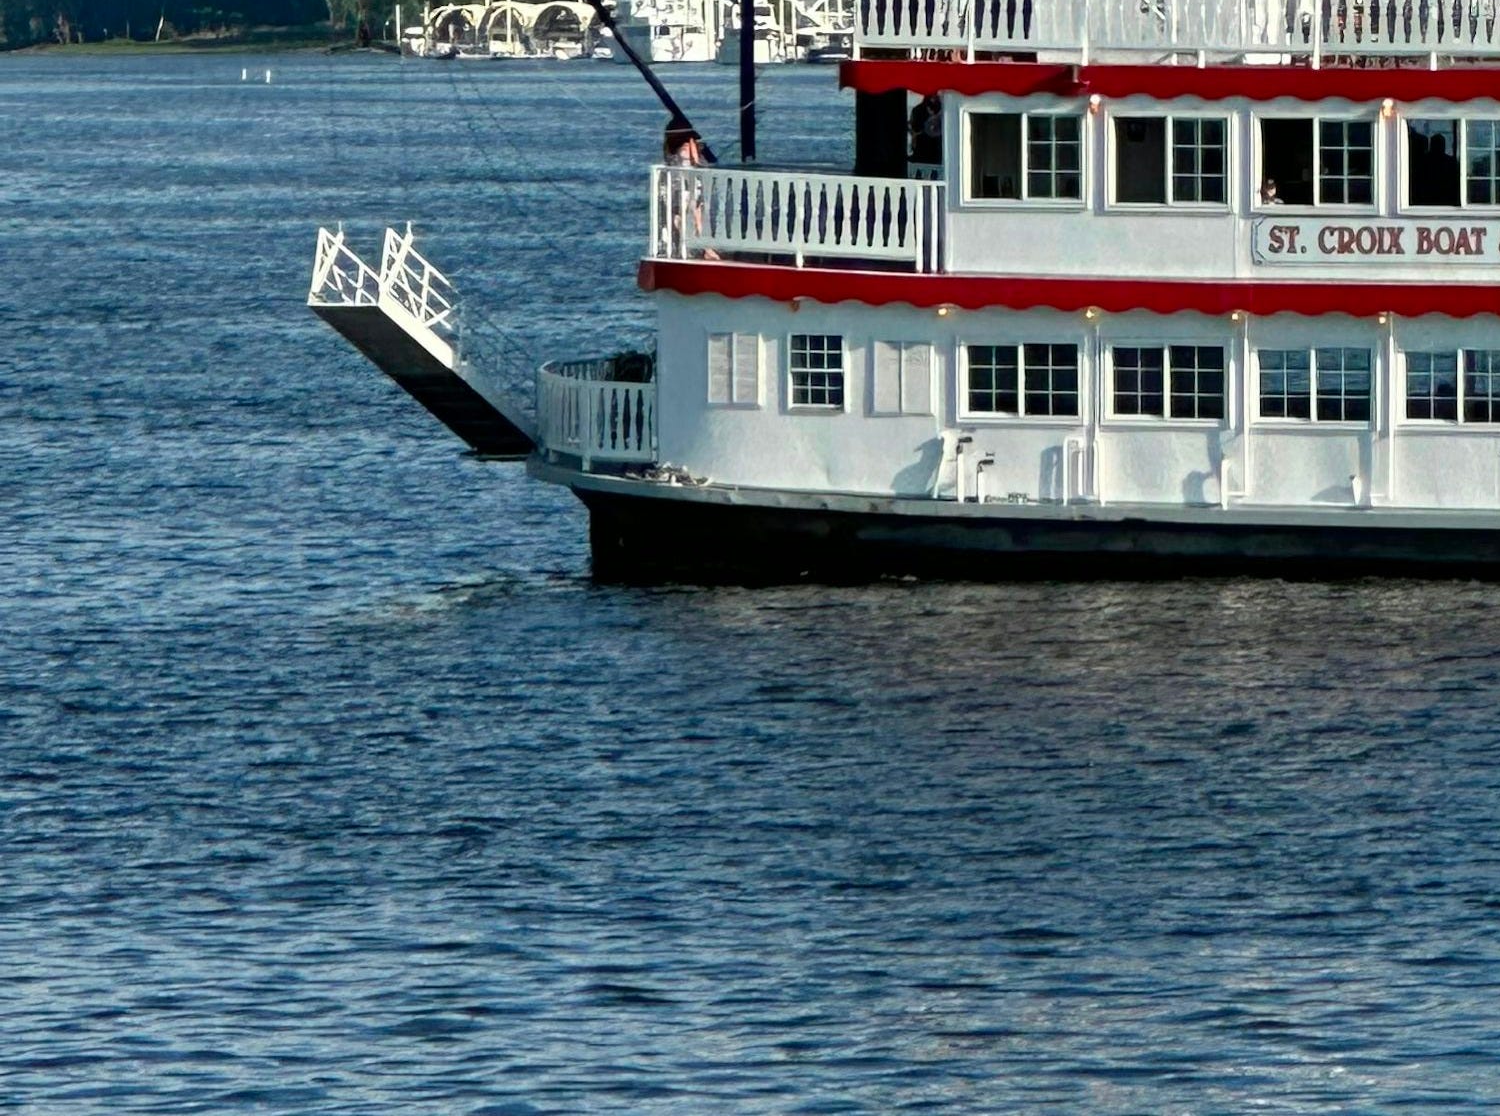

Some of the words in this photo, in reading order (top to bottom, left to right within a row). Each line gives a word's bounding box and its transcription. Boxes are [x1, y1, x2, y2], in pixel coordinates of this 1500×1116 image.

[1267, 225, 1307, 254] ST.
[1318, 225, 1405, 255] CROIX
[1416, 226, 1487, 255] BOAT
